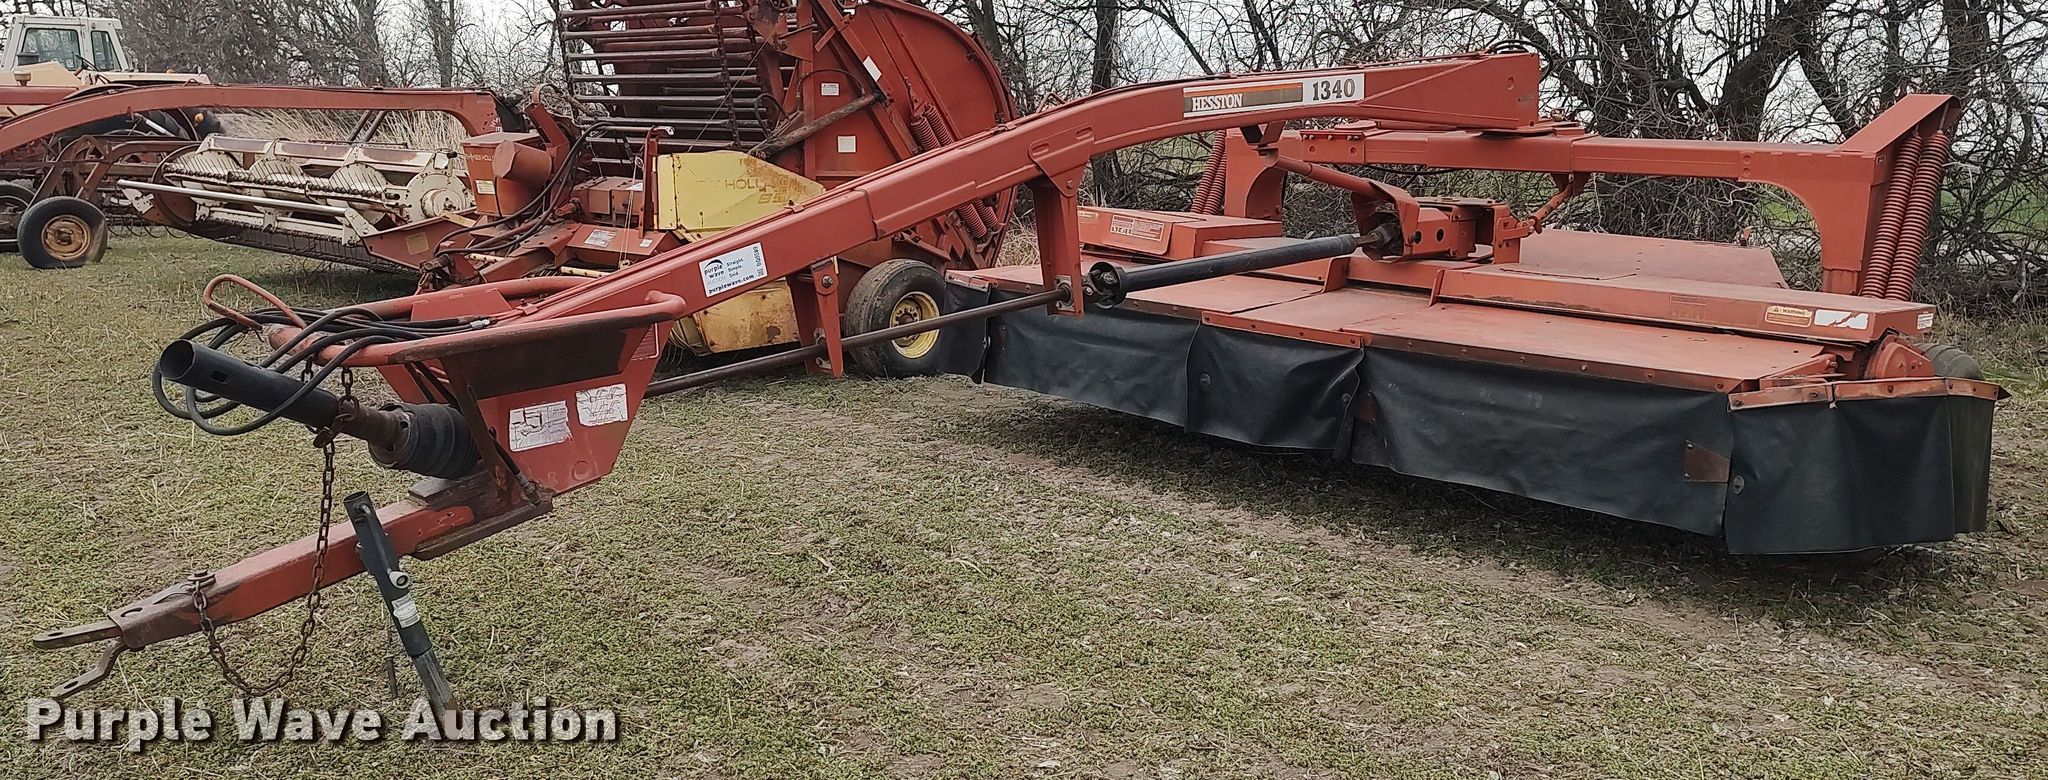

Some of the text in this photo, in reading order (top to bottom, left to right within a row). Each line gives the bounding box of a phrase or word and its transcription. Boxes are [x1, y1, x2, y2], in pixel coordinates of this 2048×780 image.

[1312, 78, 1356, 101] 1340
[1191, 93, 1243, 112] HESSTON
[704, 264, 723, 275] purple
[709, 274, 755, 294] purplewave.com
